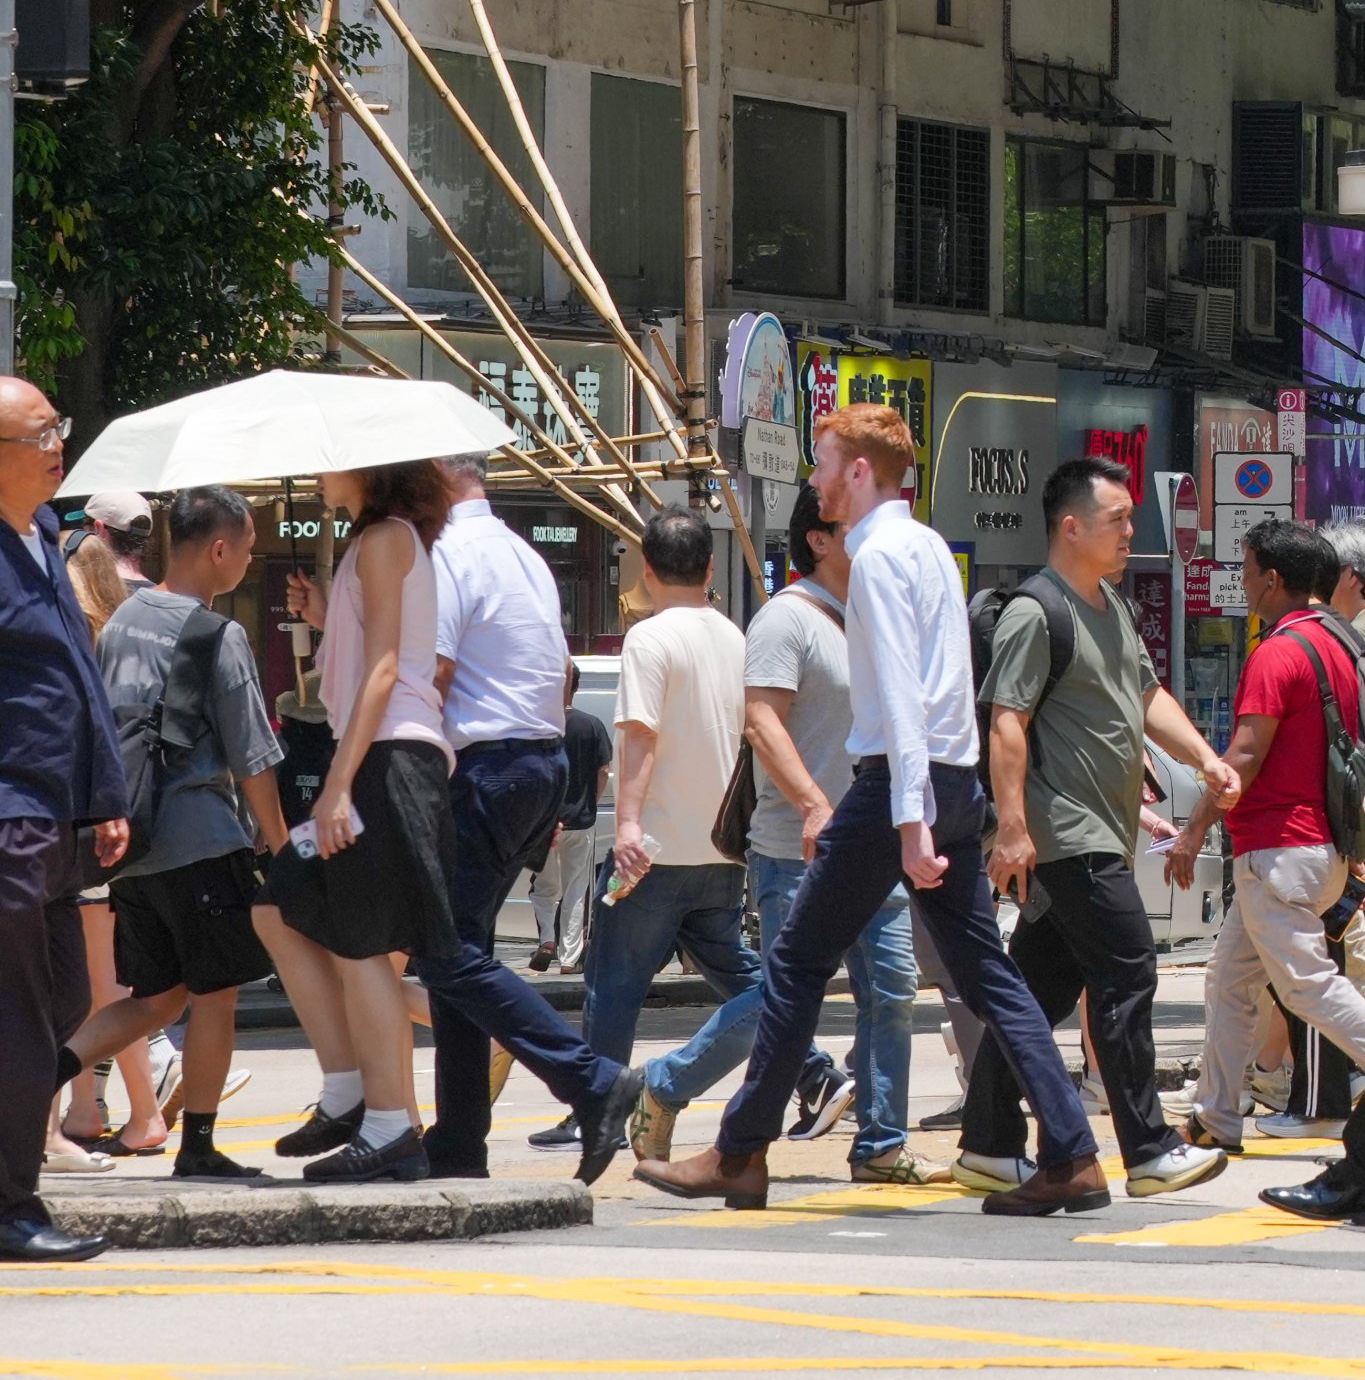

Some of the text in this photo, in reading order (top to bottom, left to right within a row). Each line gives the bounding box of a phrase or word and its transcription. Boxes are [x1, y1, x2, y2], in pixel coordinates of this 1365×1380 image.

[1220, 583, 1238, 591] pick
[1215, 593, 1248, 604] 的士上
